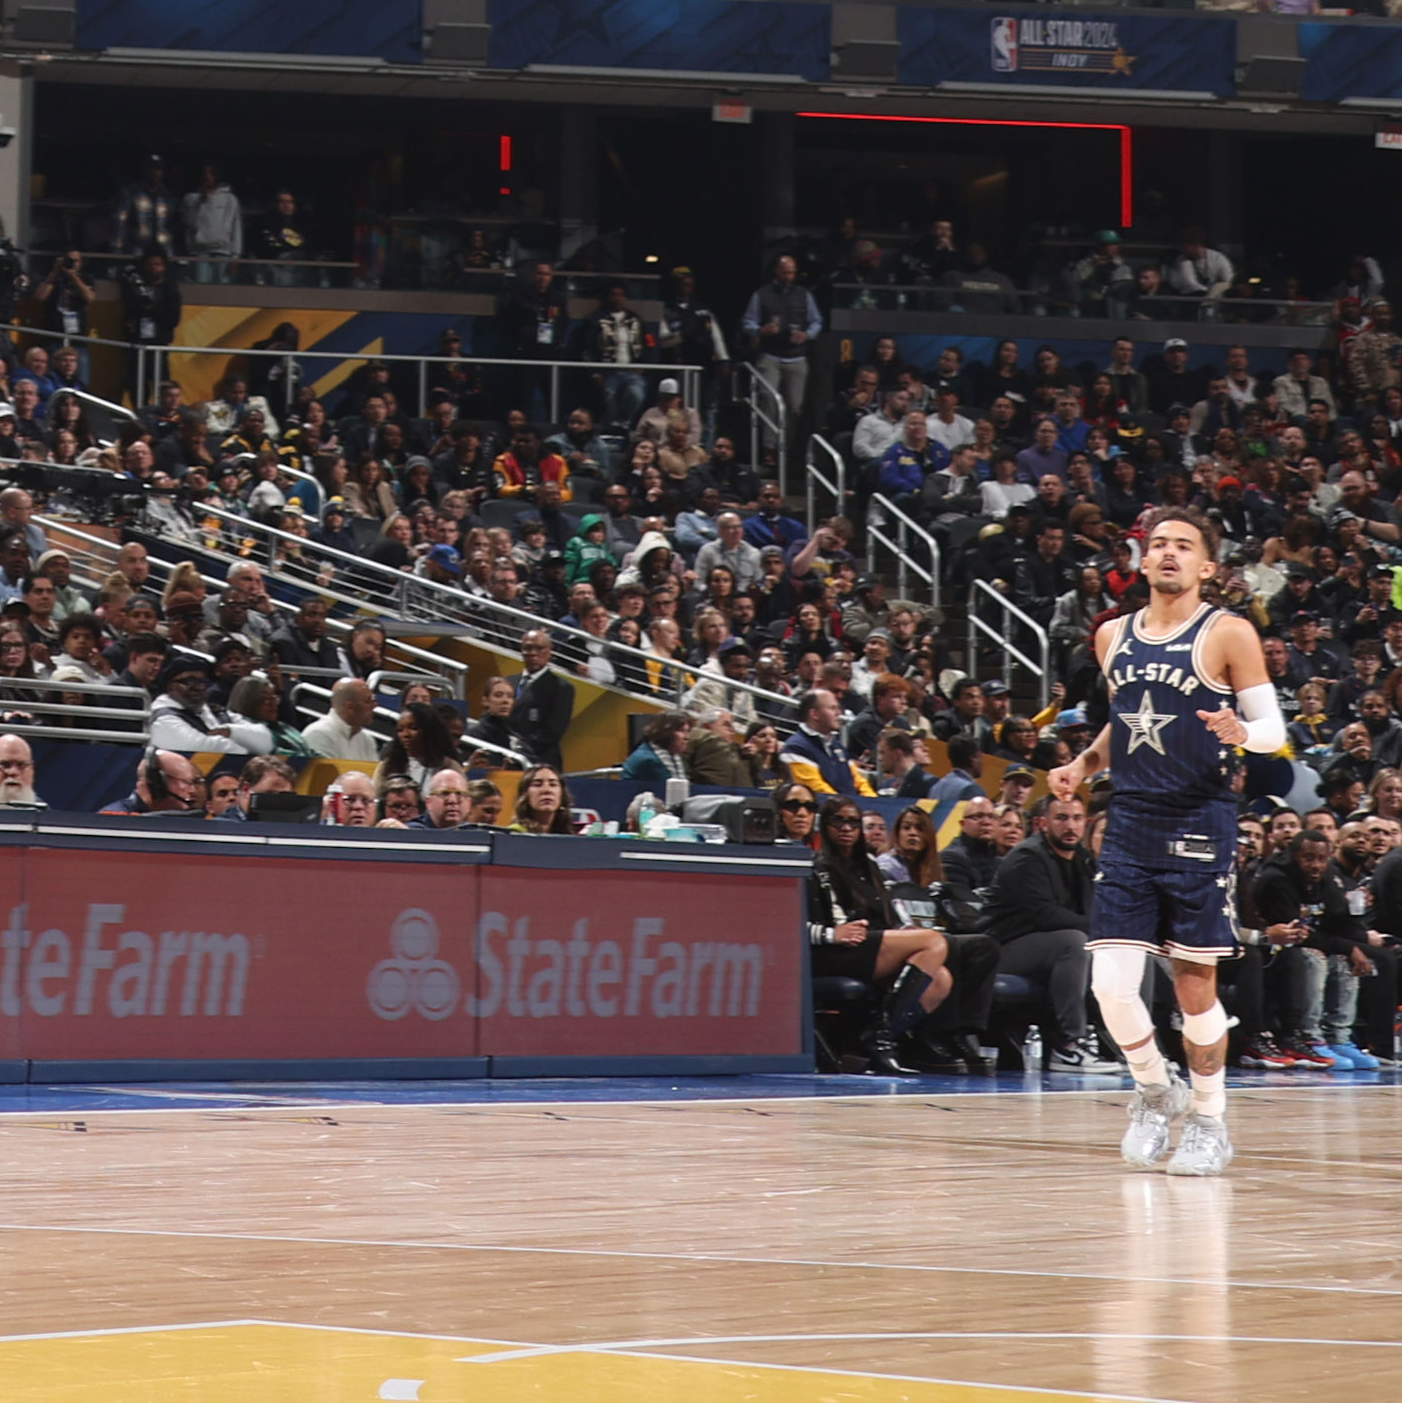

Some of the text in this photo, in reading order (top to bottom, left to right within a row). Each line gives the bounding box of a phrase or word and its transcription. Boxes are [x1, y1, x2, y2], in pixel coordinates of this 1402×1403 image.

[1020, 19, 1119, 48] ALL-STAR 2024
[1052, 53, 1089, 68] INDY
